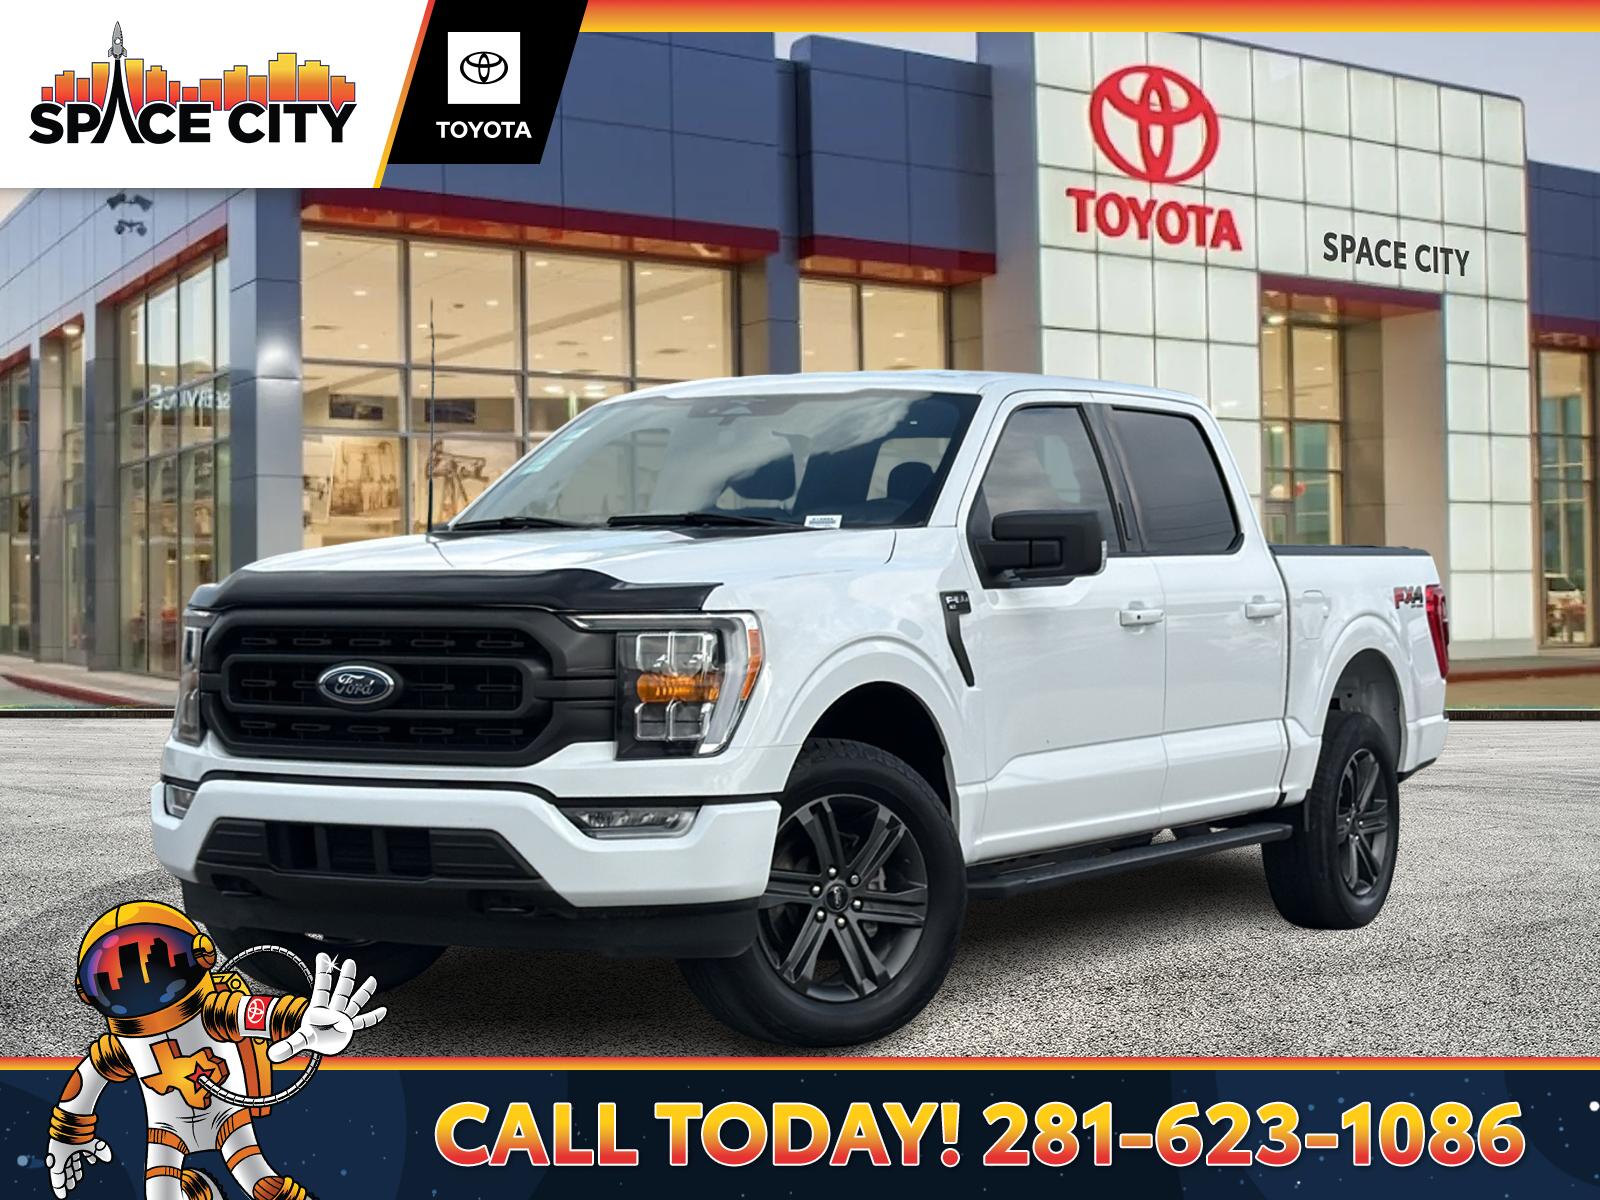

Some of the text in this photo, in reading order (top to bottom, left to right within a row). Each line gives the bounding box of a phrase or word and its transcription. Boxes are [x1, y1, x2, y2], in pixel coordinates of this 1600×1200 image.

[1067, 188, 1242, 251] TOYOTA
[1323, 232, 1471, 277] SPACE CITY
[334, 673, 375, 695] Ford
